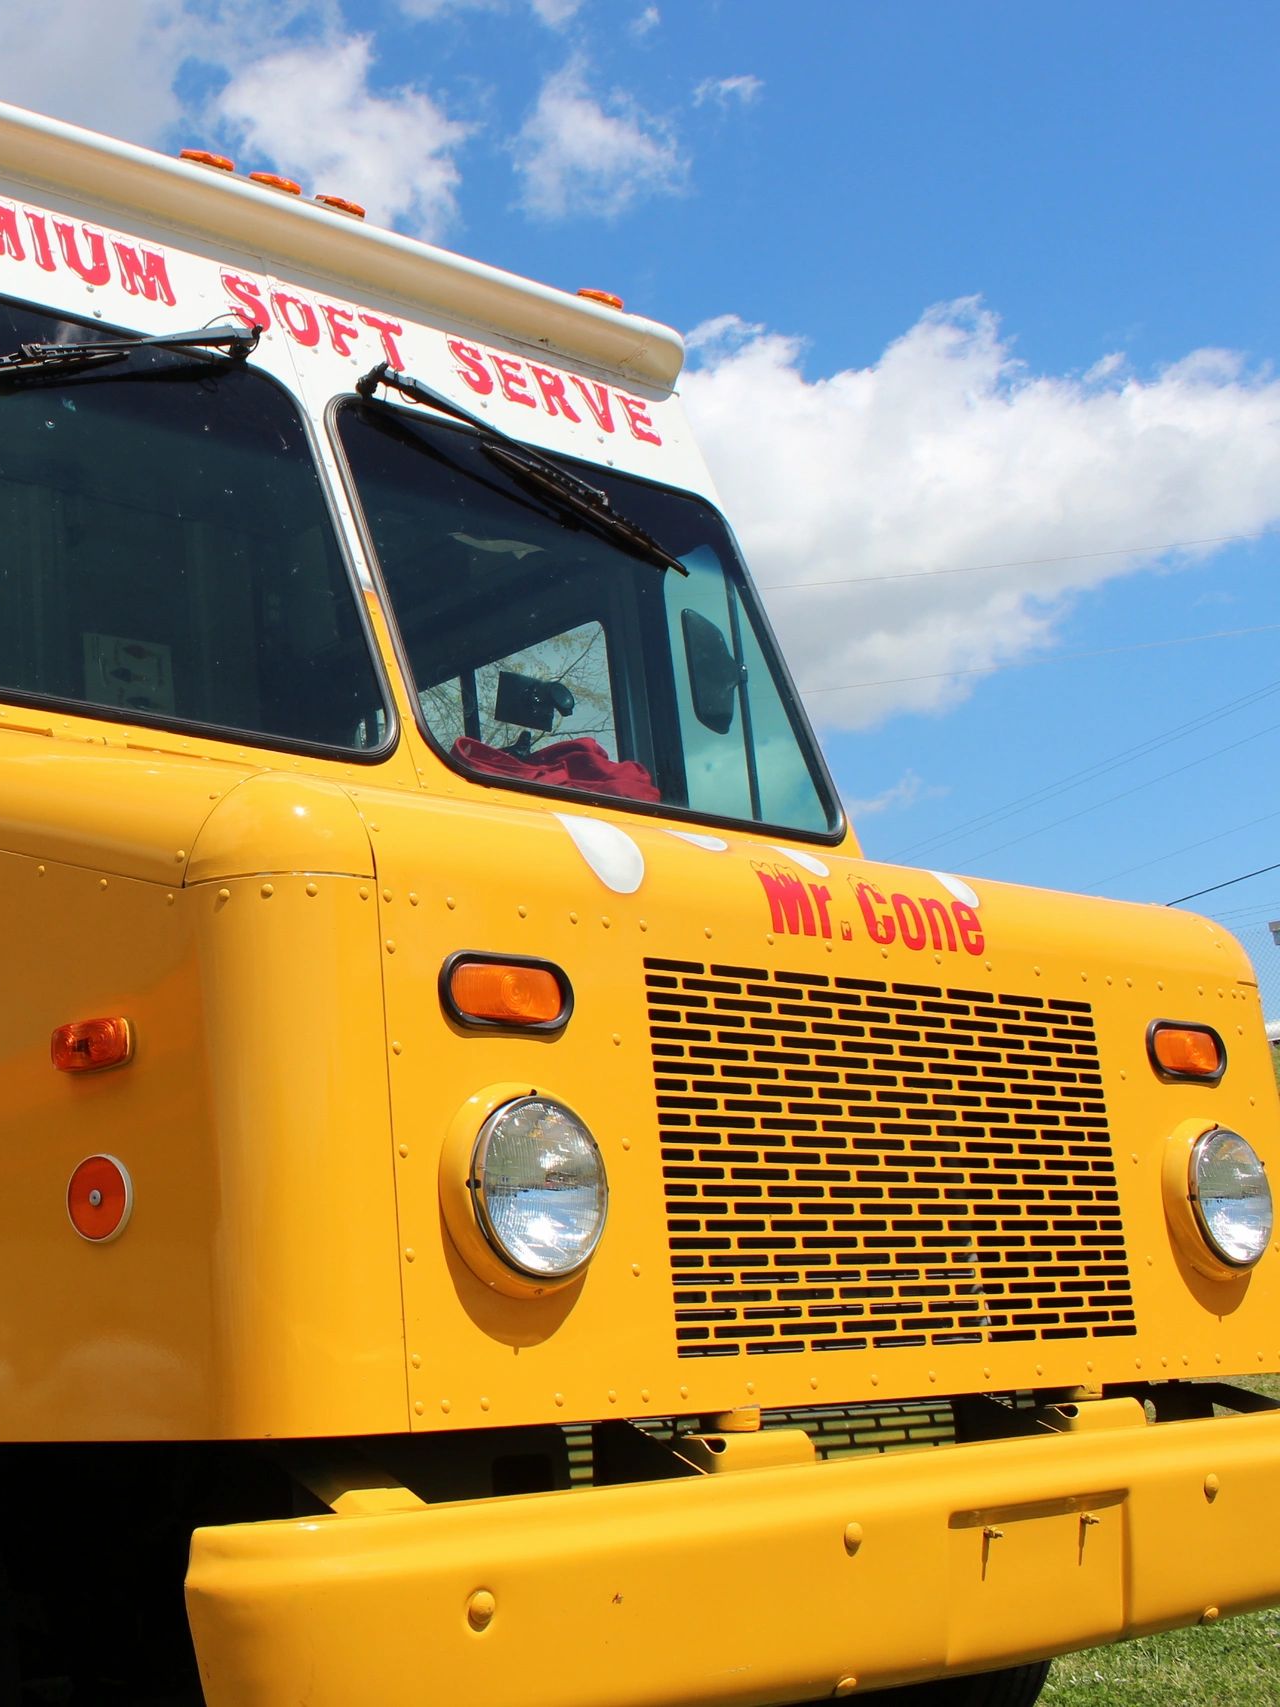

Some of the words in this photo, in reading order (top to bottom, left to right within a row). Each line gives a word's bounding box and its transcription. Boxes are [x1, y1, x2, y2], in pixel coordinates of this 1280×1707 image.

[219, 266, 406, 372] SOFT
[446, 333, 663, 447] SERVE
[750, 860, 853, 941] Mr.
[847, 874, 985, 956] Cone
